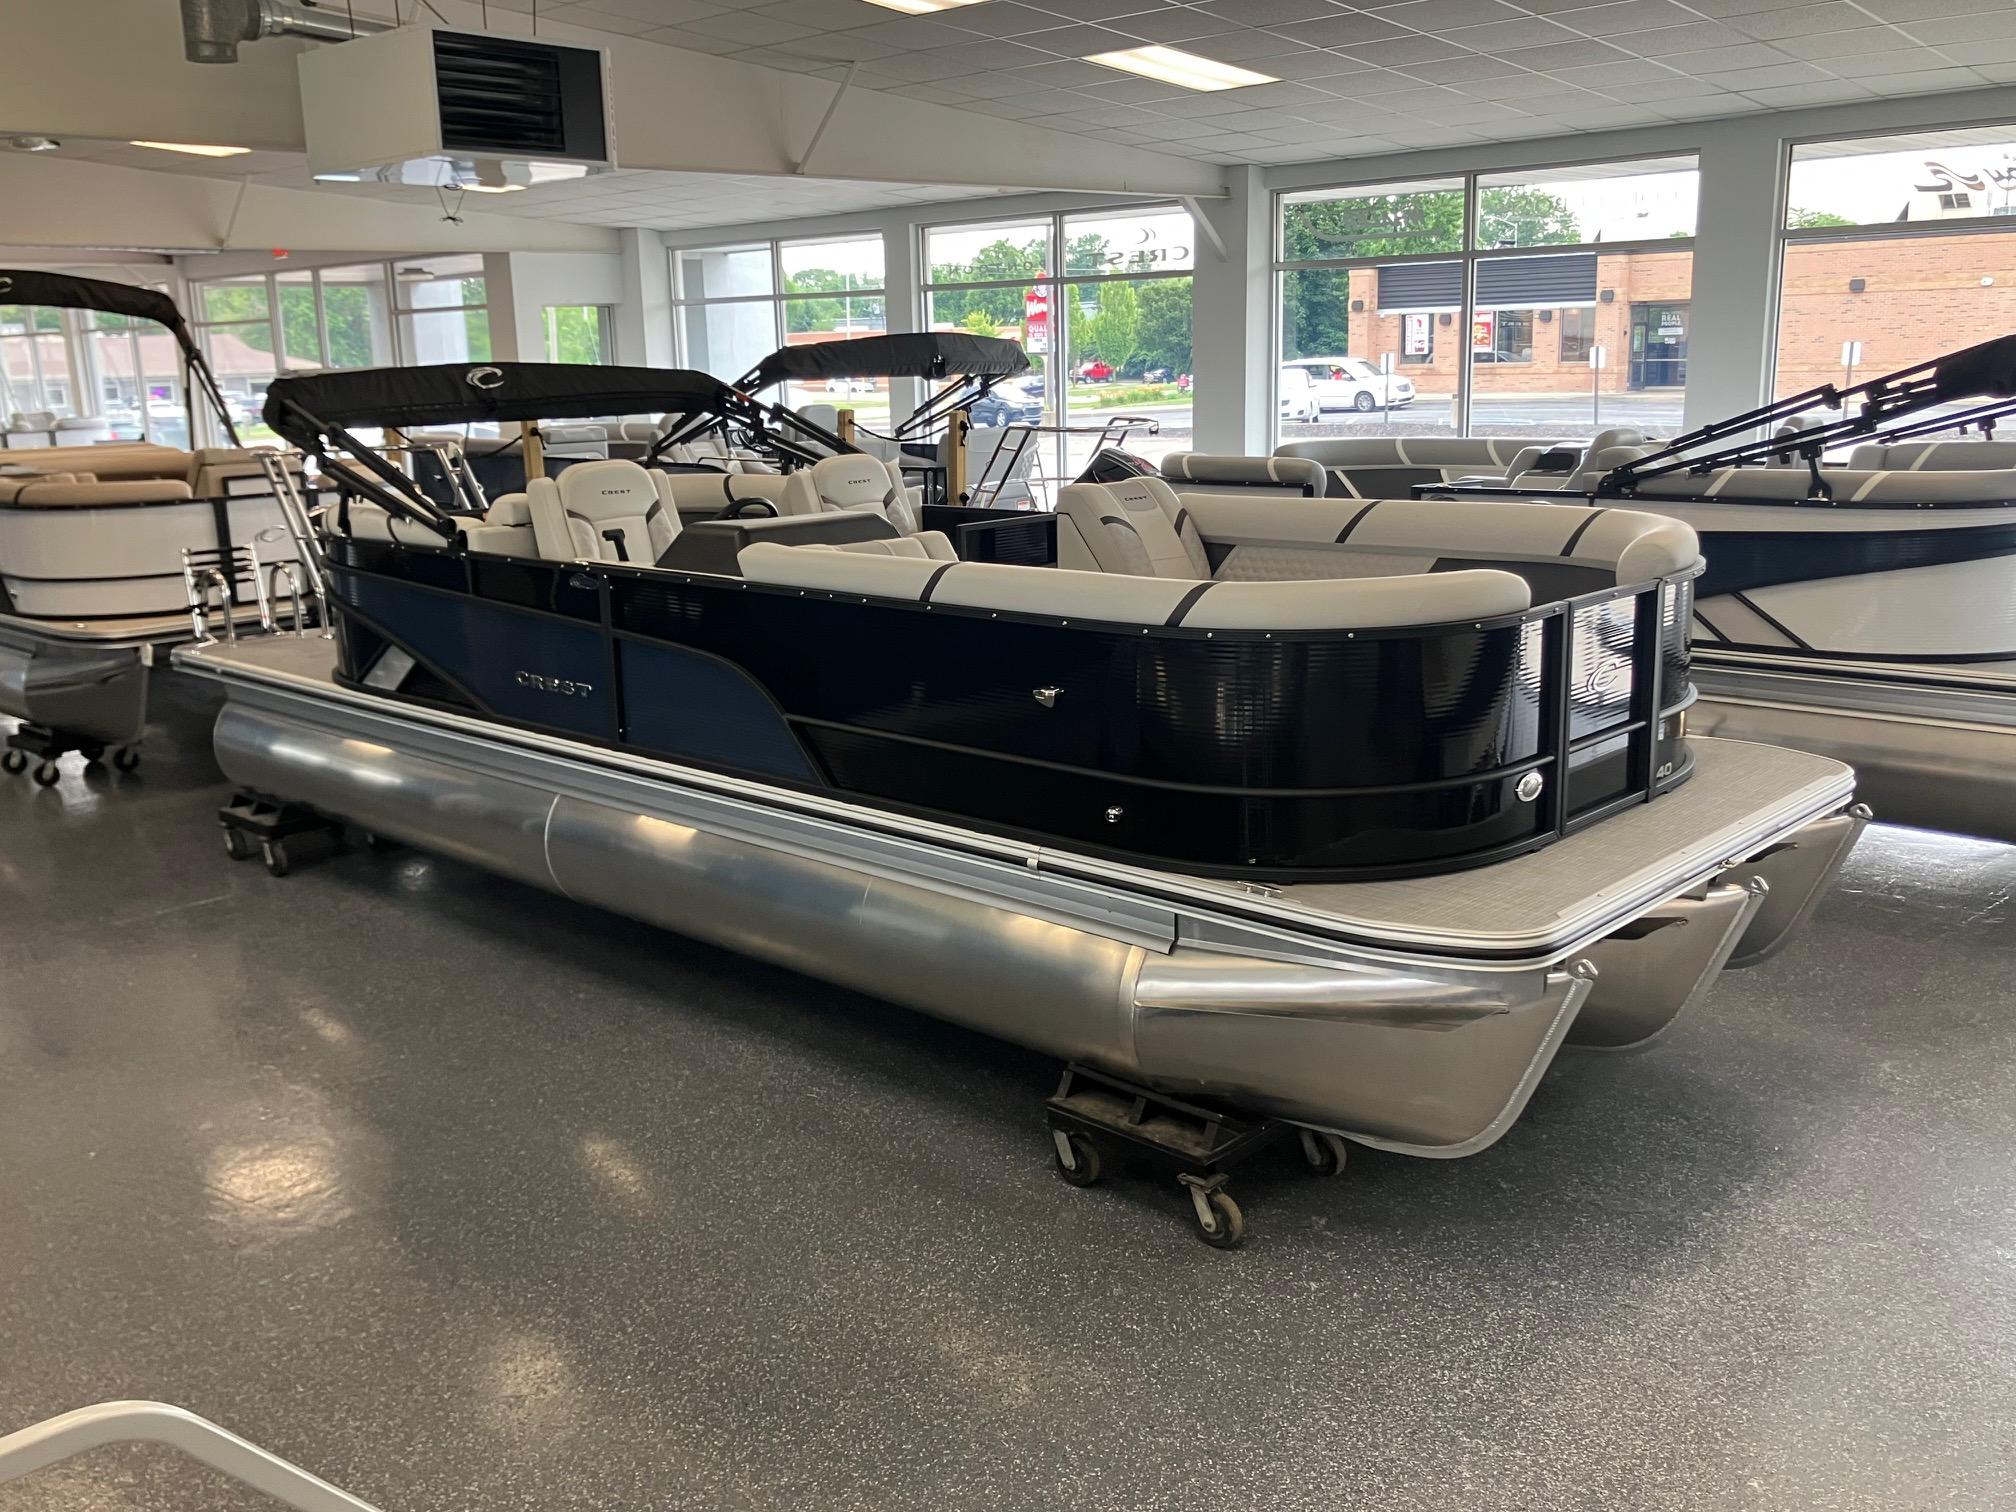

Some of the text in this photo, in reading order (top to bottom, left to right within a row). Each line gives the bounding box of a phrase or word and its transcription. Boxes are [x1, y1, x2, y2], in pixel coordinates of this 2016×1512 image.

[601, 488, 632, 496] CREST
[514, 670, 593, 698] CREST
[1656, 762, 1672, 777] 40
